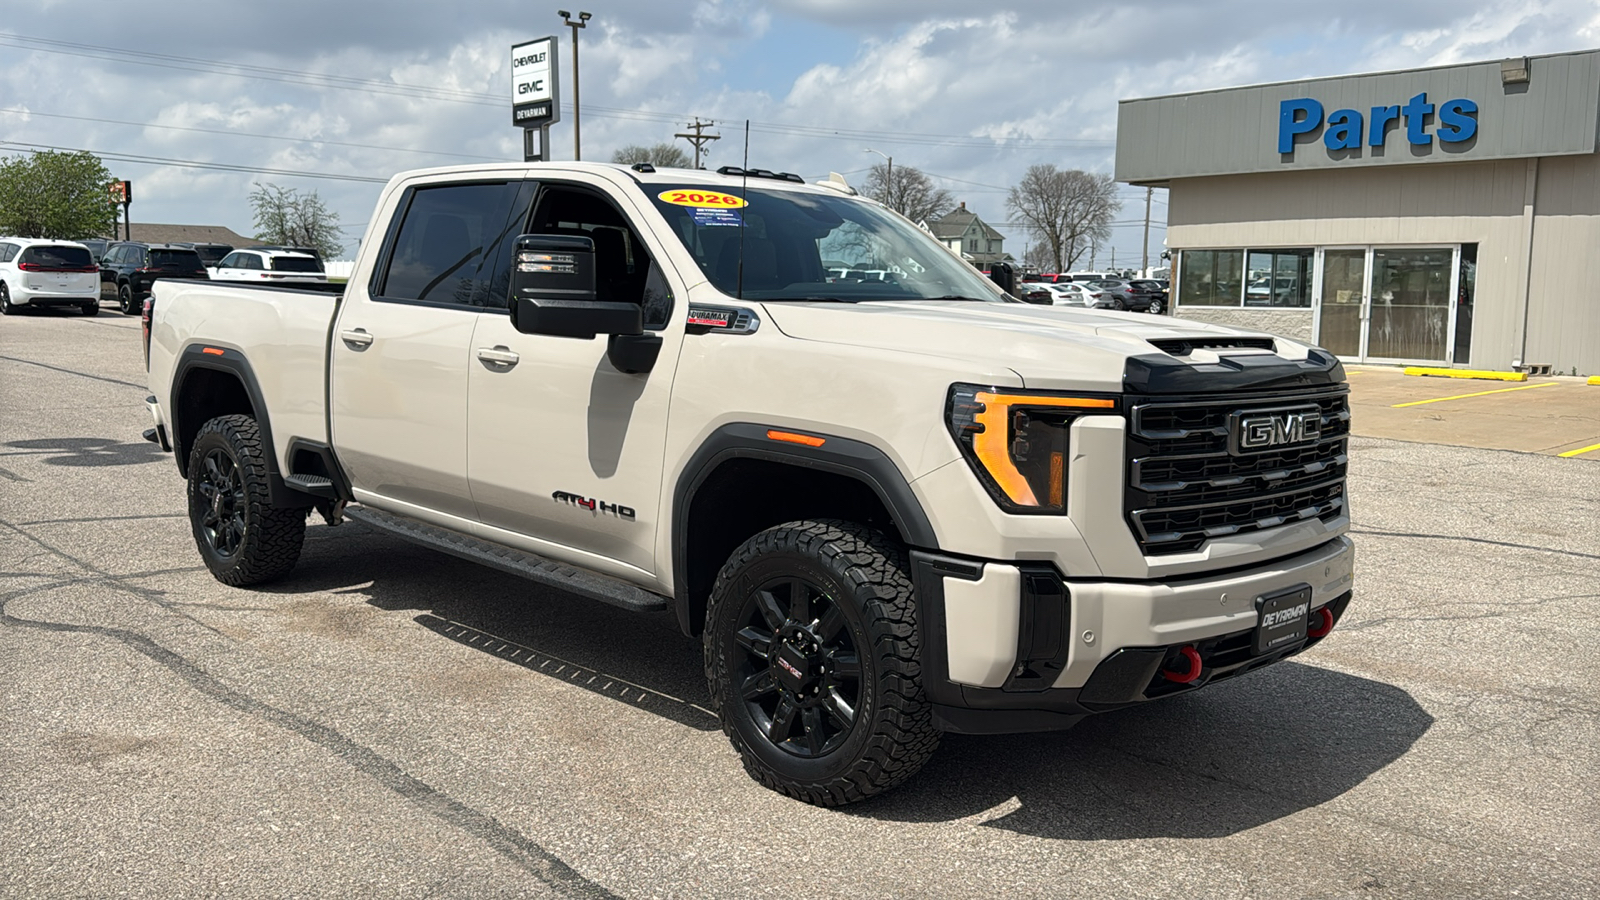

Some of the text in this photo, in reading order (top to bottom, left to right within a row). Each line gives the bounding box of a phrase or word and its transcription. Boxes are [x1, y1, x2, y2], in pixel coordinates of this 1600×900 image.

[513, 52, 546, 68] CHEVROLET
[518, 79, 543, 95] GMC
[516, 106, 547, 120] DEYARMAN
[1278, 92, 1479, 154] Parts
[671, 192, 738, 205] 2026
[690, 310, 728, 321] DURAMAX
[1241, 412, 1320, 448] GMC
[552, 490, 635, 518] AT4 HD
[1261, 602, 1309, 628] DEYARMAN
